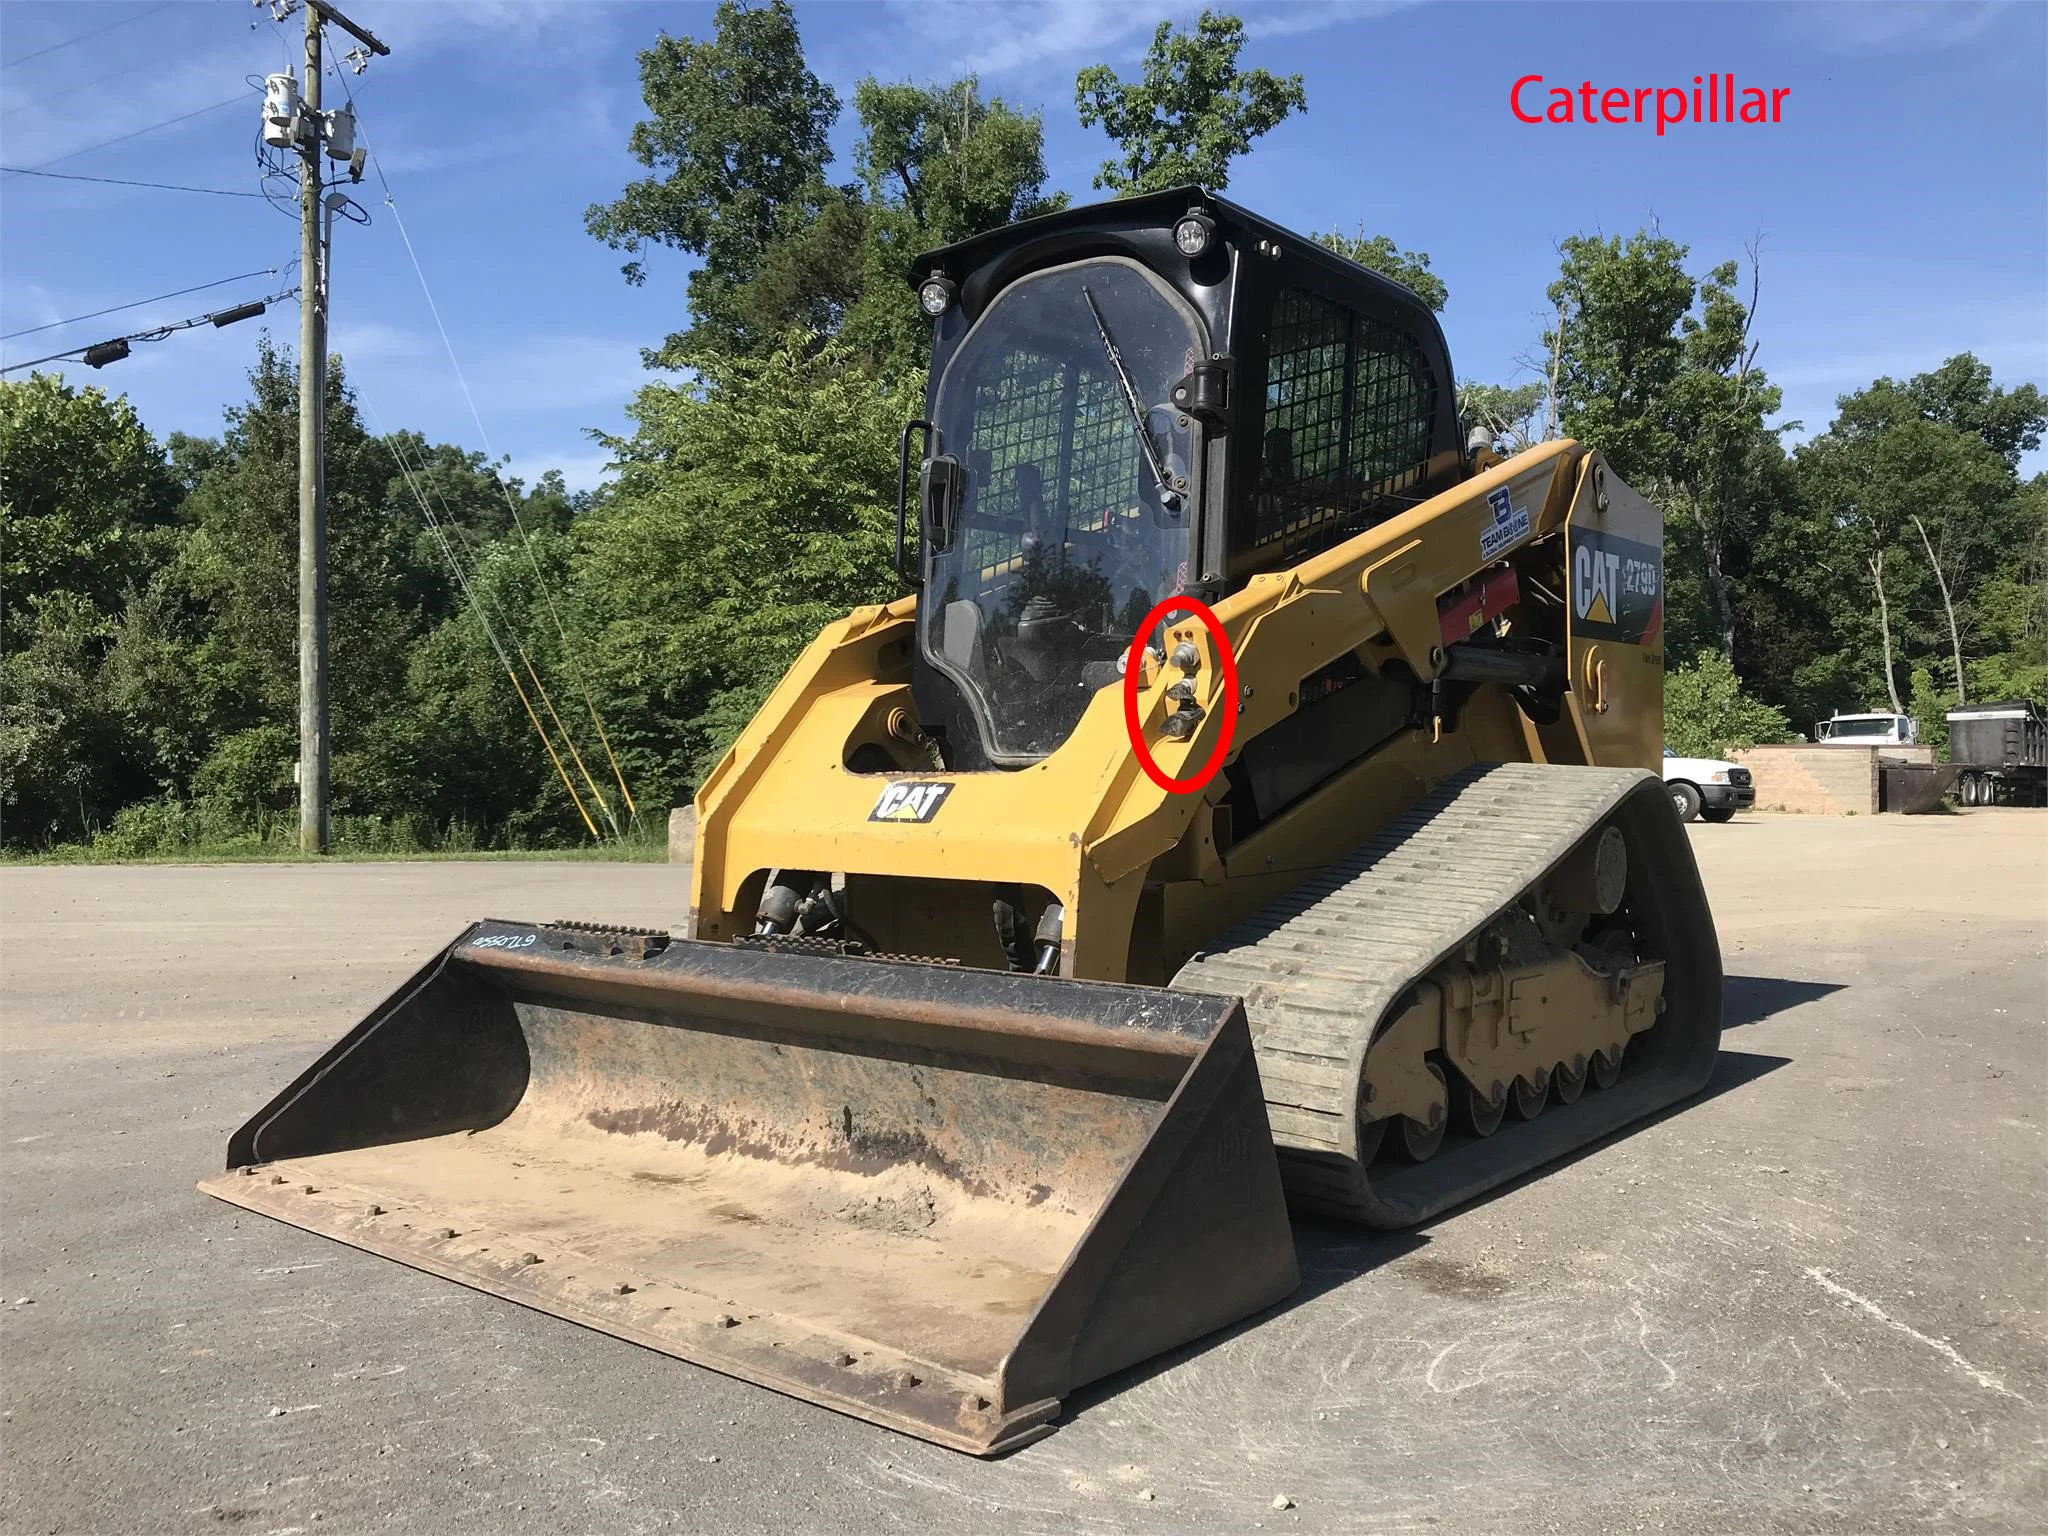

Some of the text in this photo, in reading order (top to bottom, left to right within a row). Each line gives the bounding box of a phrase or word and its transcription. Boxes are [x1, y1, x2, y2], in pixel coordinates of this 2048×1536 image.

[1575, 545, 1656, 625] CAT 279D
[876, 785, 947, 820] CAT
